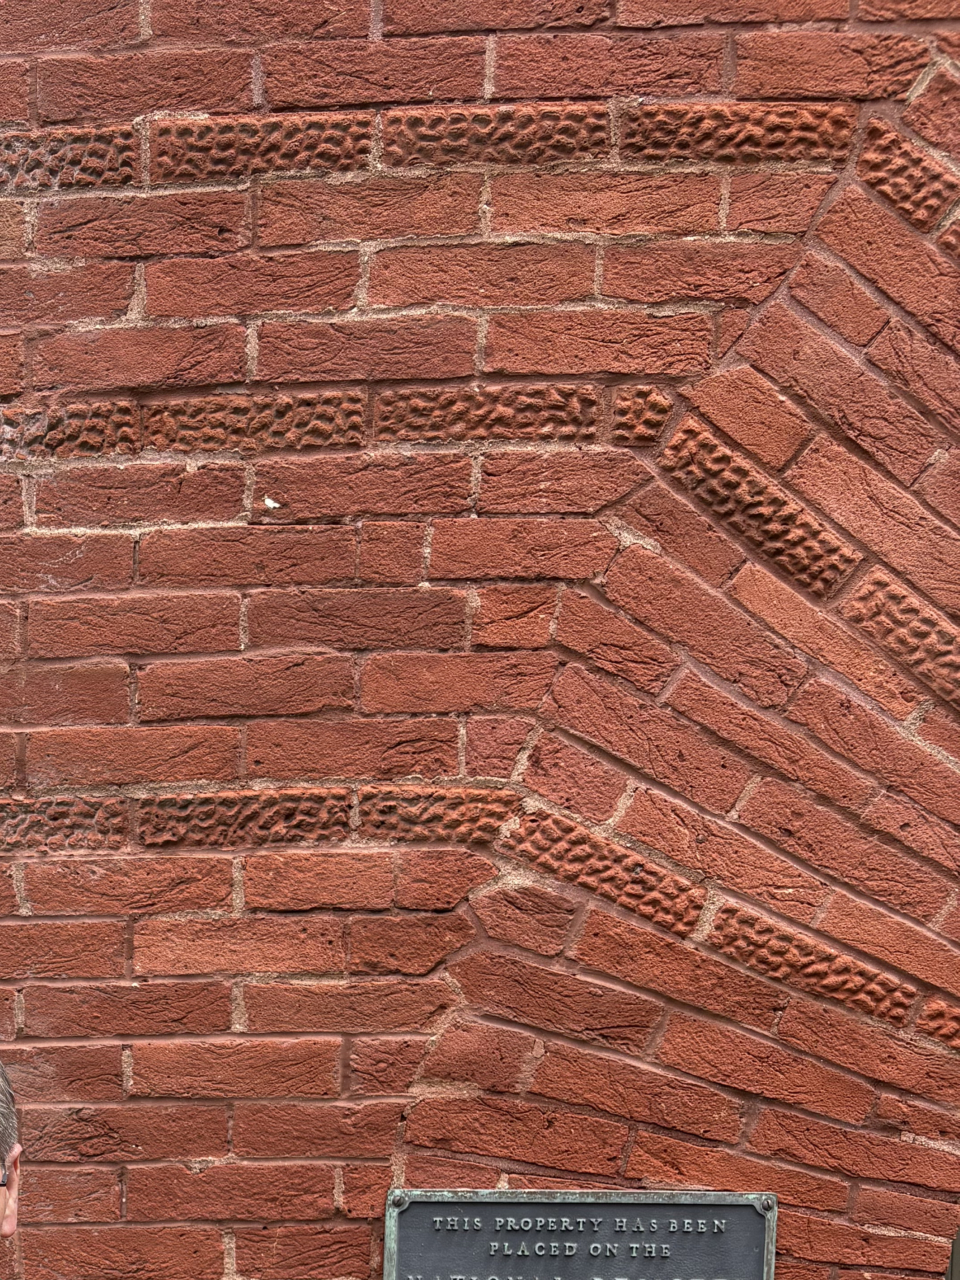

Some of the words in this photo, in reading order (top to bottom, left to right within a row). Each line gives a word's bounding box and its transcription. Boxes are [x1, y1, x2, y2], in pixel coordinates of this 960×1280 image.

[433, 1217, 482, 1232] THIS
[495, 1217, 603, 1233] PROPERTY
[615, 1218, 658, 1233] HAS
[669, 1220, 726, 1233] BEEN
[489, 1242, 577, 1257] PLACED
[590, 1243, 618, 1257] ON
[630, 1244, 671, 1257] THE
